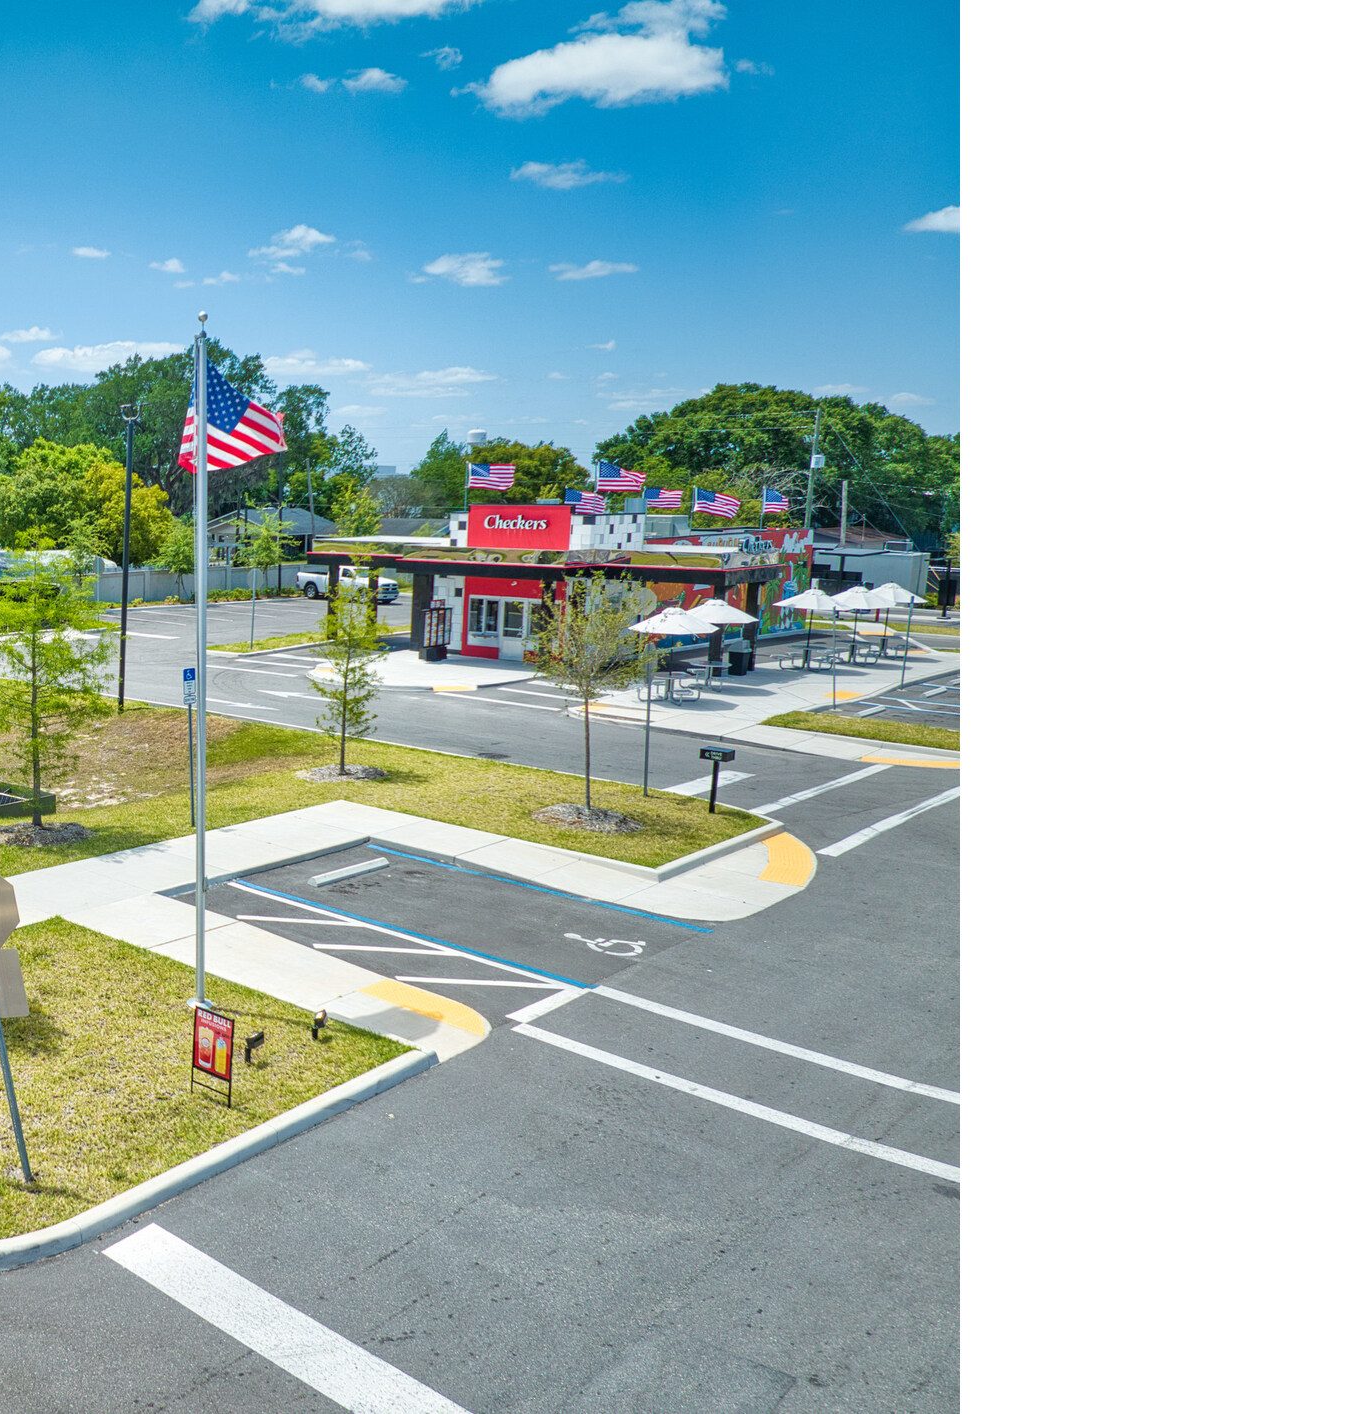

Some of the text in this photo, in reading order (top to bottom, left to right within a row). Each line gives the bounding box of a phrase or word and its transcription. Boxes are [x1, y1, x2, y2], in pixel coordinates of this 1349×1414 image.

[483, 514, 548, 530] Checkers
[197, 1008, 231, 1028] RED BULL
